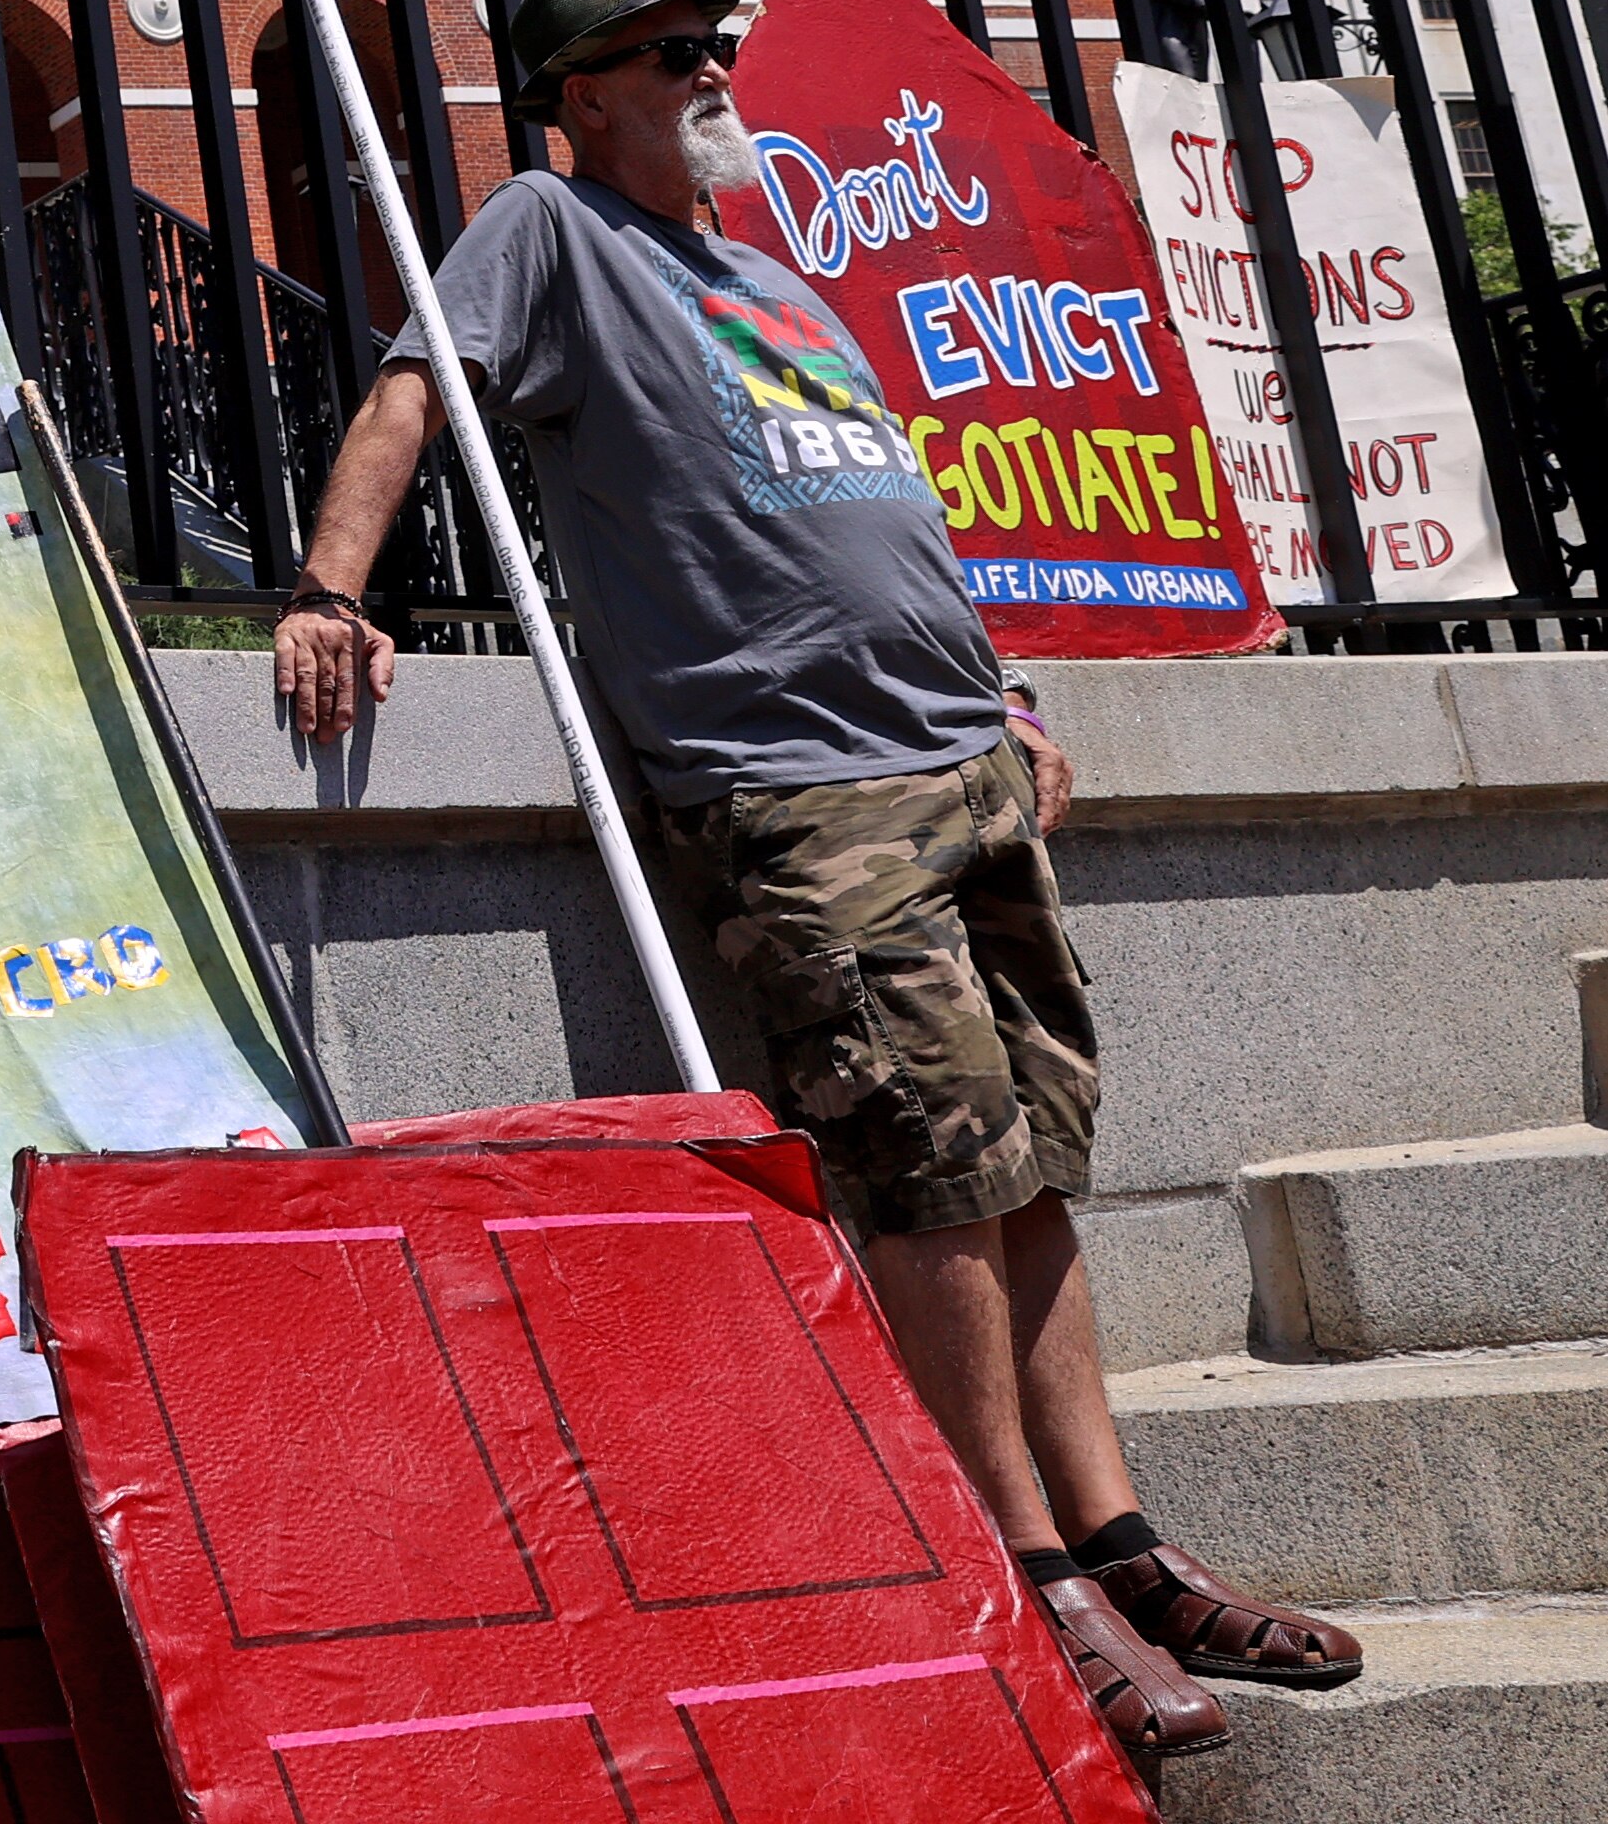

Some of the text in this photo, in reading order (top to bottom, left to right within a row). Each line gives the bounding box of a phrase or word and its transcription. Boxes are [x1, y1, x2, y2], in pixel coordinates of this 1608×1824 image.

[751, 89, 989, 278] Don't
[1166, 236, 1415, 331] EVICTNS
[897, 273, 1161, 400] EVICT
[761, 420, 919, 474] 1865
[893, 413, 1221, 539] GOTIATE!
[970, 562, 1237, 606] IFE/VIDA URBANA
[557, 717, 591, 782] EAGLE
